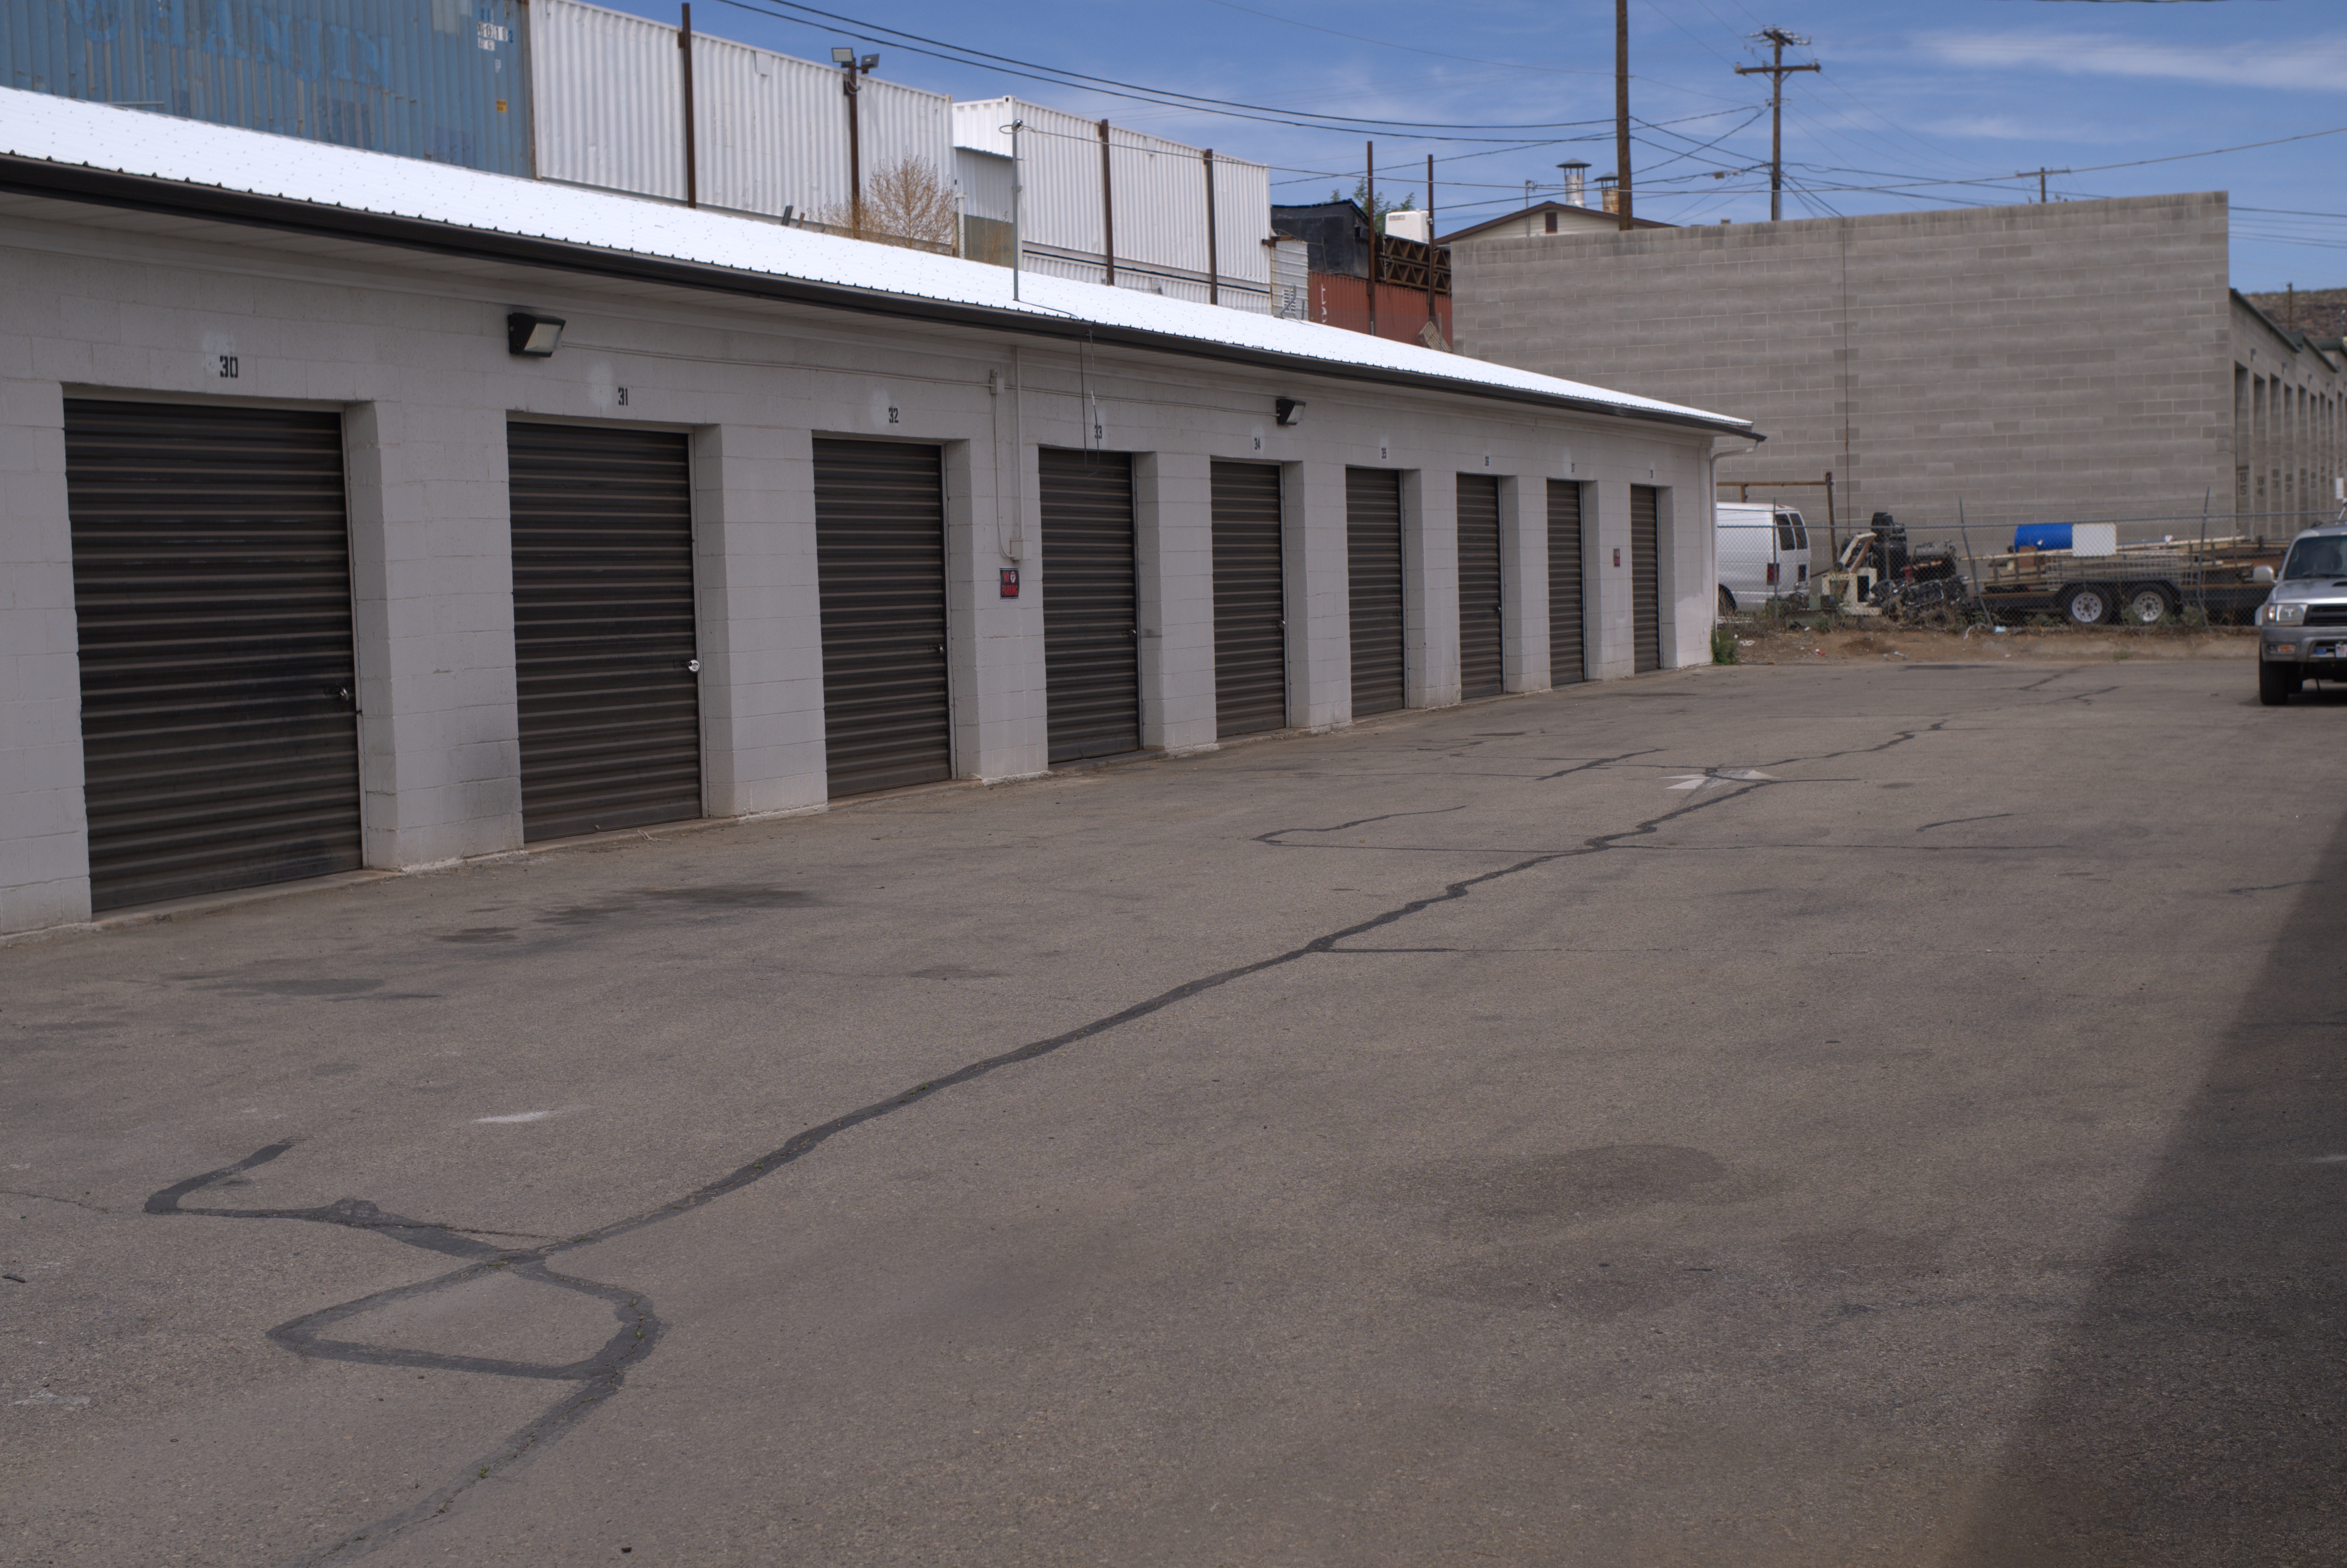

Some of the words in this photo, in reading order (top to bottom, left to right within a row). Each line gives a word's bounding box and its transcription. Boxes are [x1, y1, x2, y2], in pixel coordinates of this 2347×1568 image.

[219, 355, 239, 378] 30
[618, 387, 628, 406] 31
[888, 405, 899, 423] 32
[1094, 425, 1102, 439] 33
[1254, 438, 1261, 450] 34
[1381, 448, 1386, 459] 35
[2240, 472, 2247, 496] 85
[2257, 476, 2264, 497] 84
[1003, 571, 1009, 583] NO
[1002, 584, 1018, 596] PARKING
